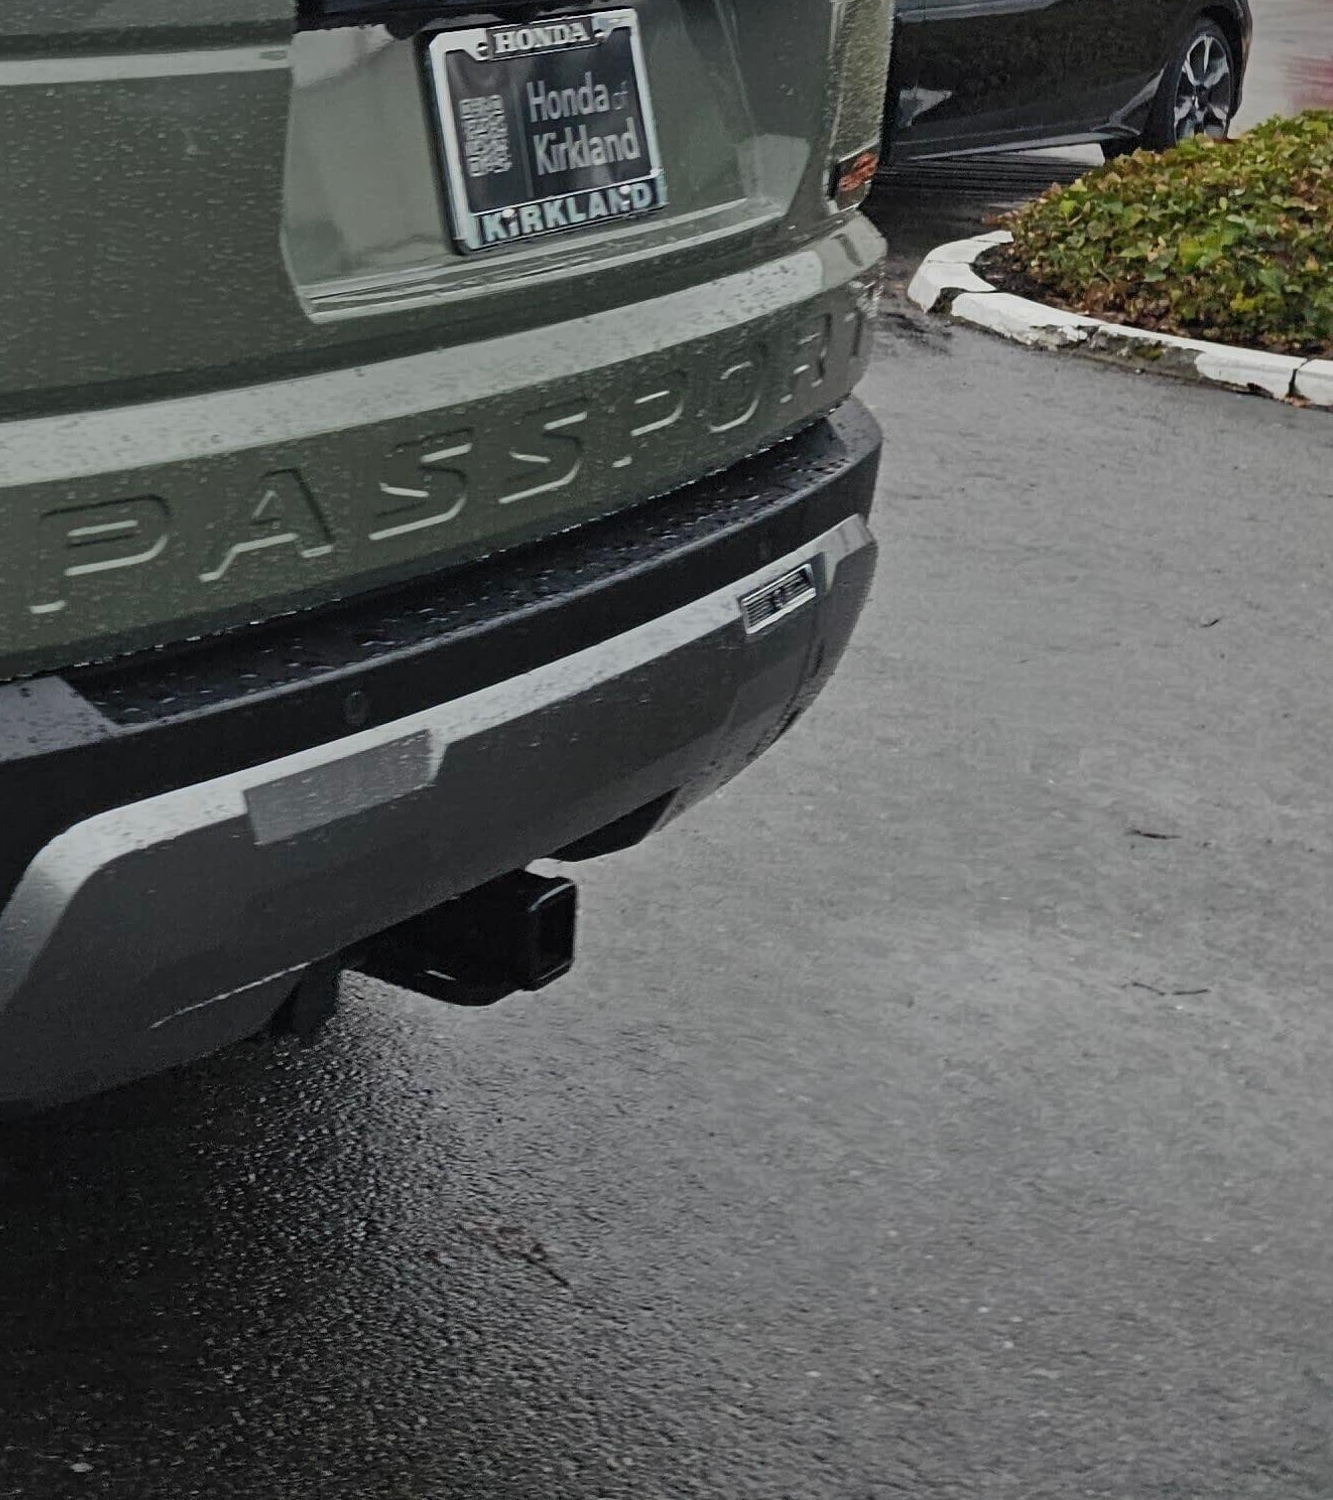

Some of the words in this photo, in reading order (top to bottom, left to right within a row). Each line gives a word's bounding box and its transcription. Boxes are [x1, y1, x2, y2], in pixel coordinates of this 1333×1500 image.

[492, 22, 590, 53] HONDA
[526, 71, 610, 122] Honda
[532, 117, 642, 176] Kirkland
[483, 182, 654, 242] KIRKLAND
